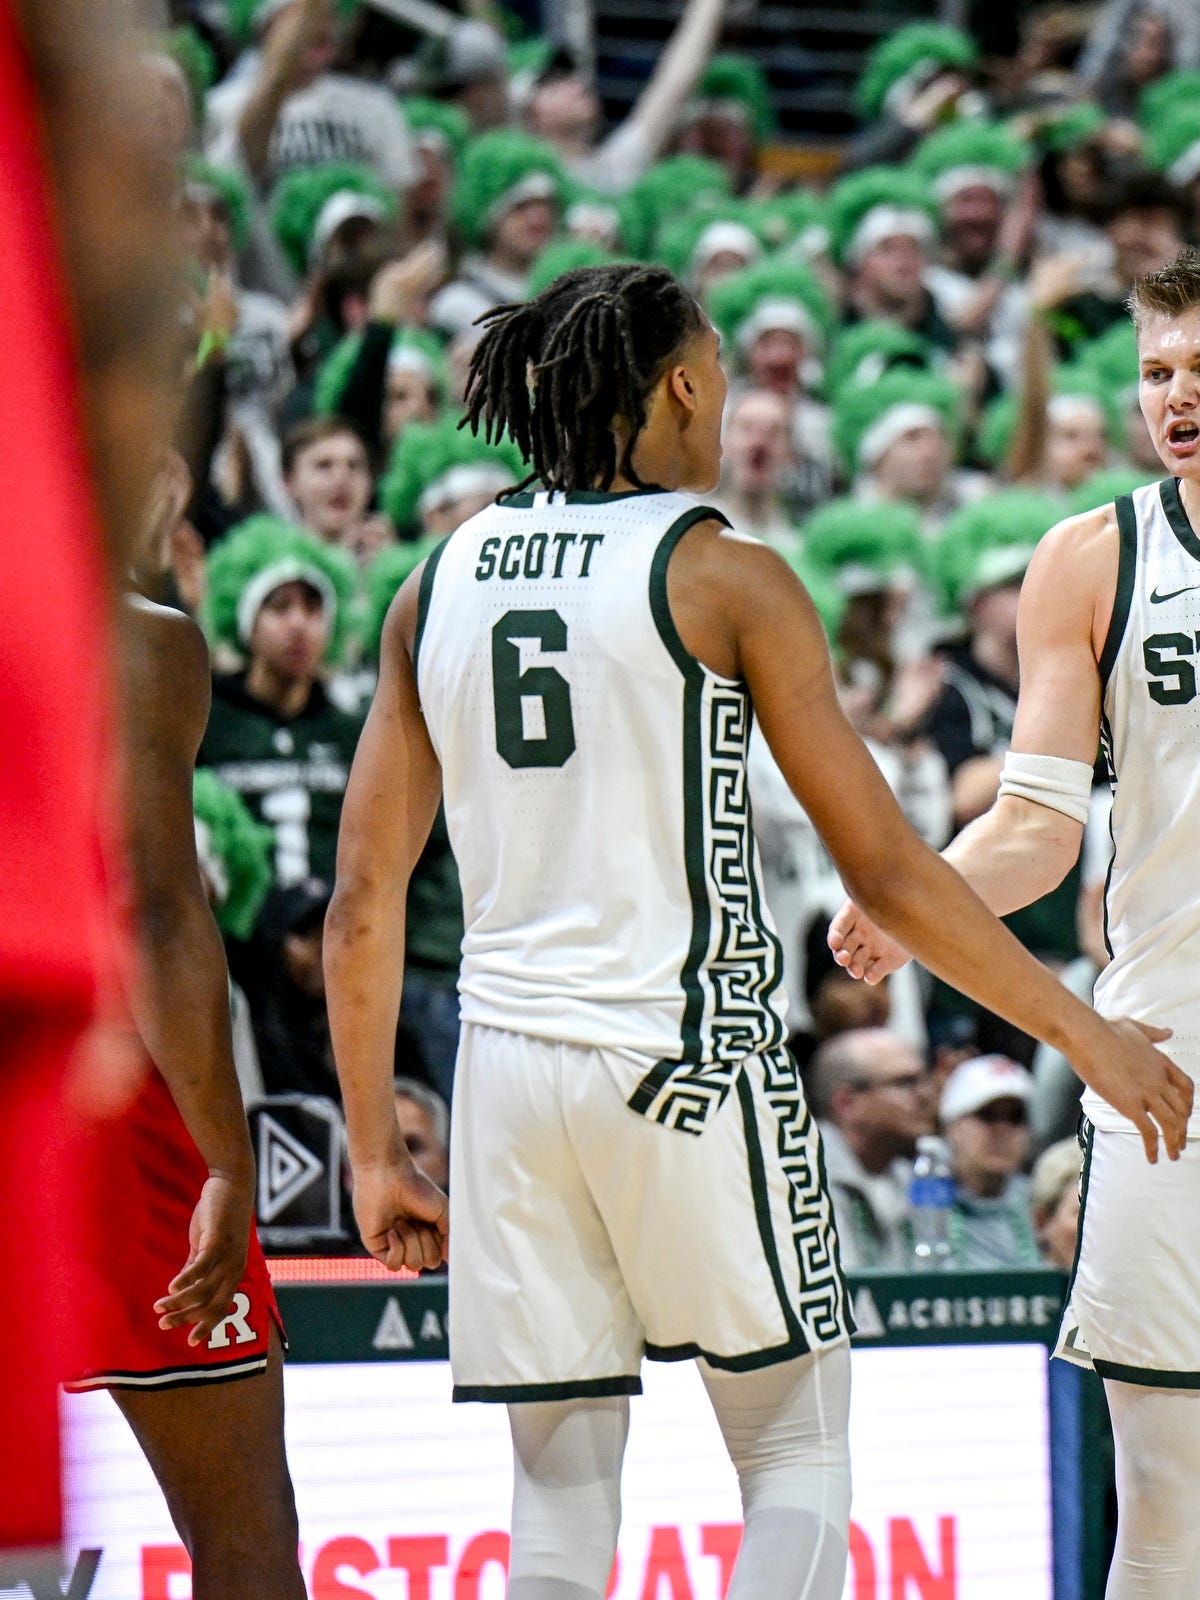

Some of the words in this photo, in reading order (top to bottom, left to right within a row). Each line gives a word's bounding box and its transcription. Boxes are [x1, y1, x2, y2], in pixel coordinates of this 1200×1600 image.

[475, 532, 605, 581] SCOTT
[491, 608, 576, 769] 6
[207, 1292, 257, 1350] R
